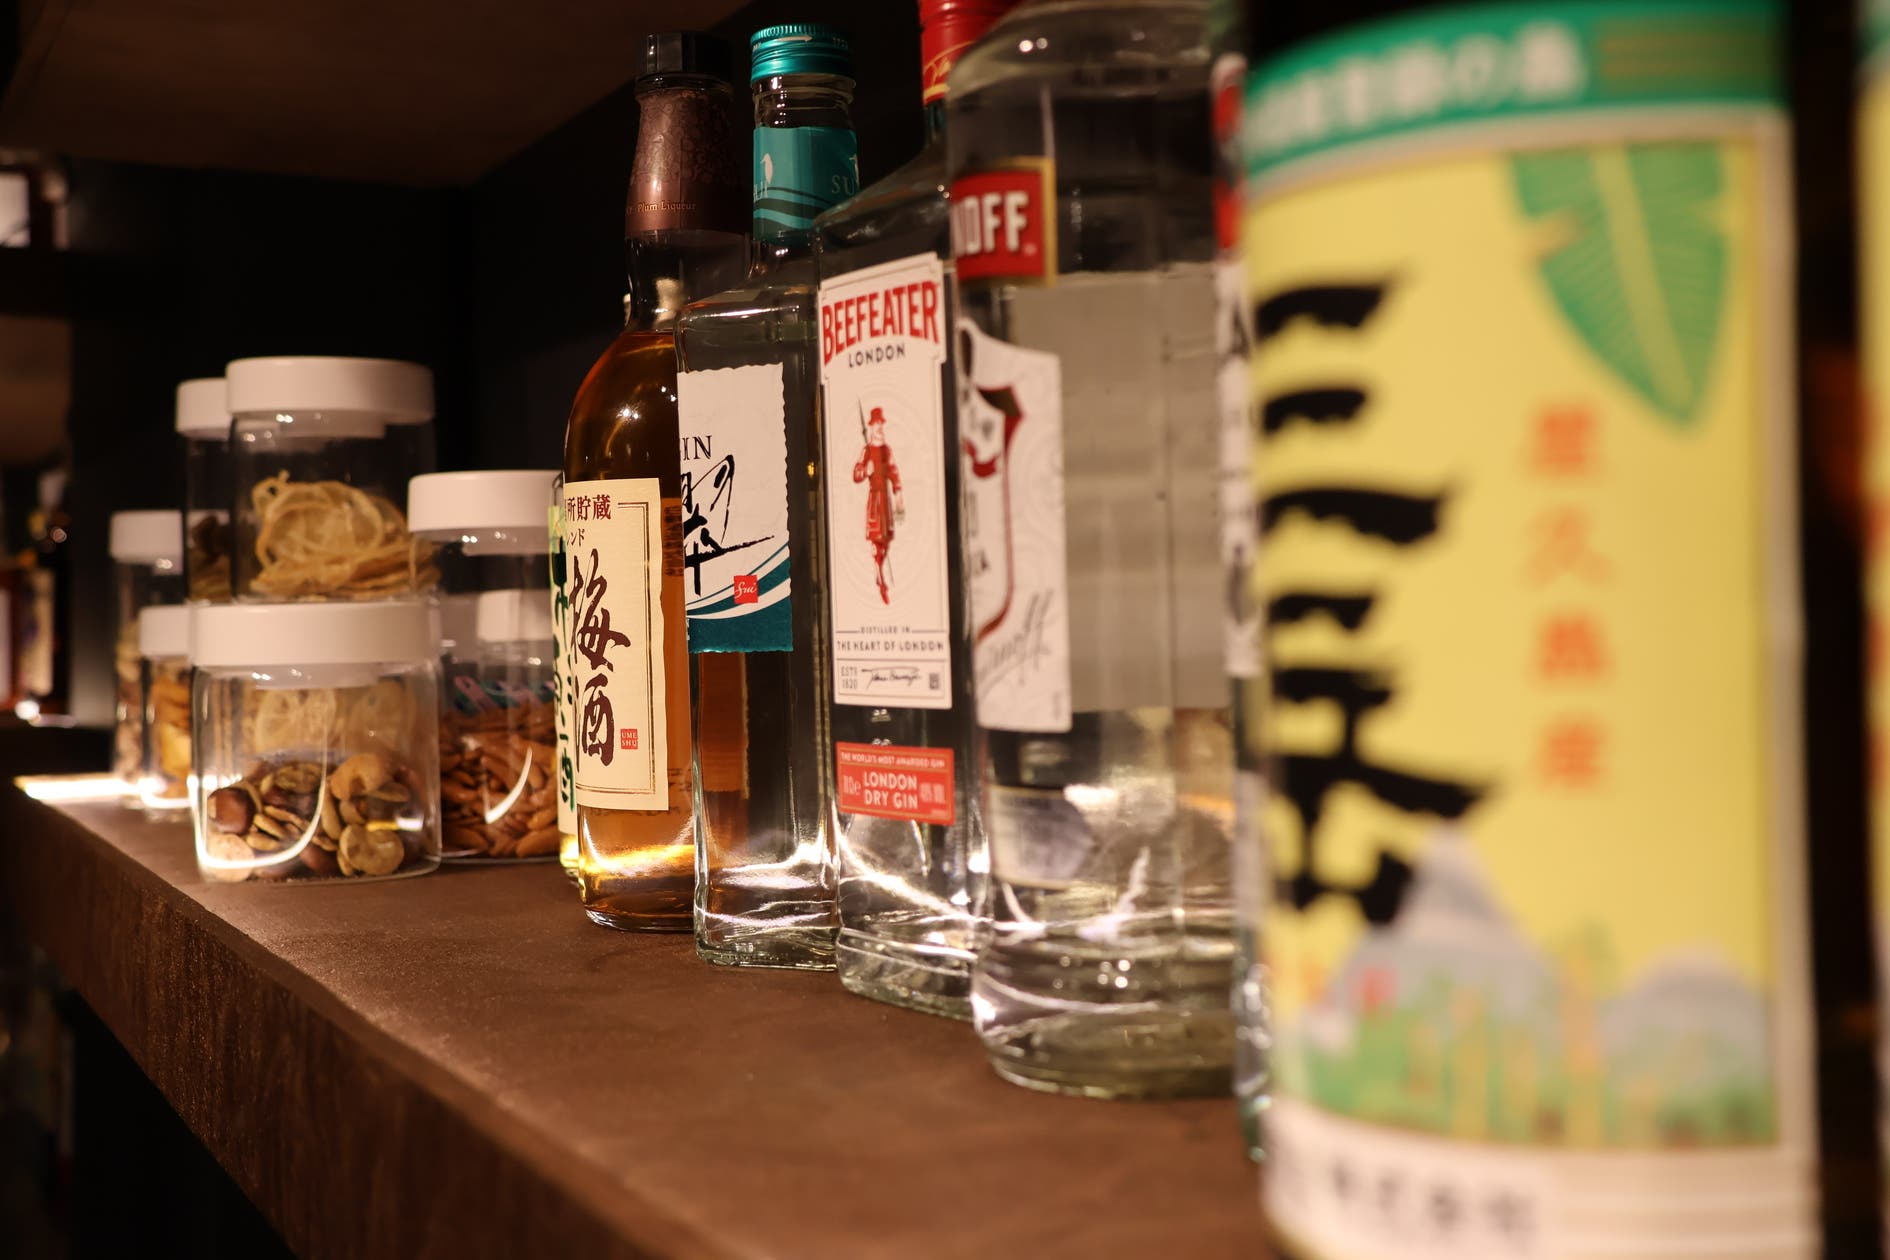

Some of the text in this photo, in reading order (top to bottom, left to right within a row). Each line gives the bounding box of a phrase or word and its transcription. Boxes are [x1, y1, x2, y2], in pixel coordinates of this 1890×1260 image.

[637, 201, 658, 214] Plum
[661, 199, 697, 213] Liqueur
[822, 281, 940, 367] BEEFEATER
[848, 344, 906, 368] LONDON
[681, 435, 712, 461] IN
[837, 640, 944, 651] THE HEART OF LONDON
[568, 548, 632, 773] 梅酒
[841, 751, 851, 761] THE
[863, 771, 918, 790] LONDON
[864, 789, 889, 806] DRY
[893, 792, 919, 809] GIN
